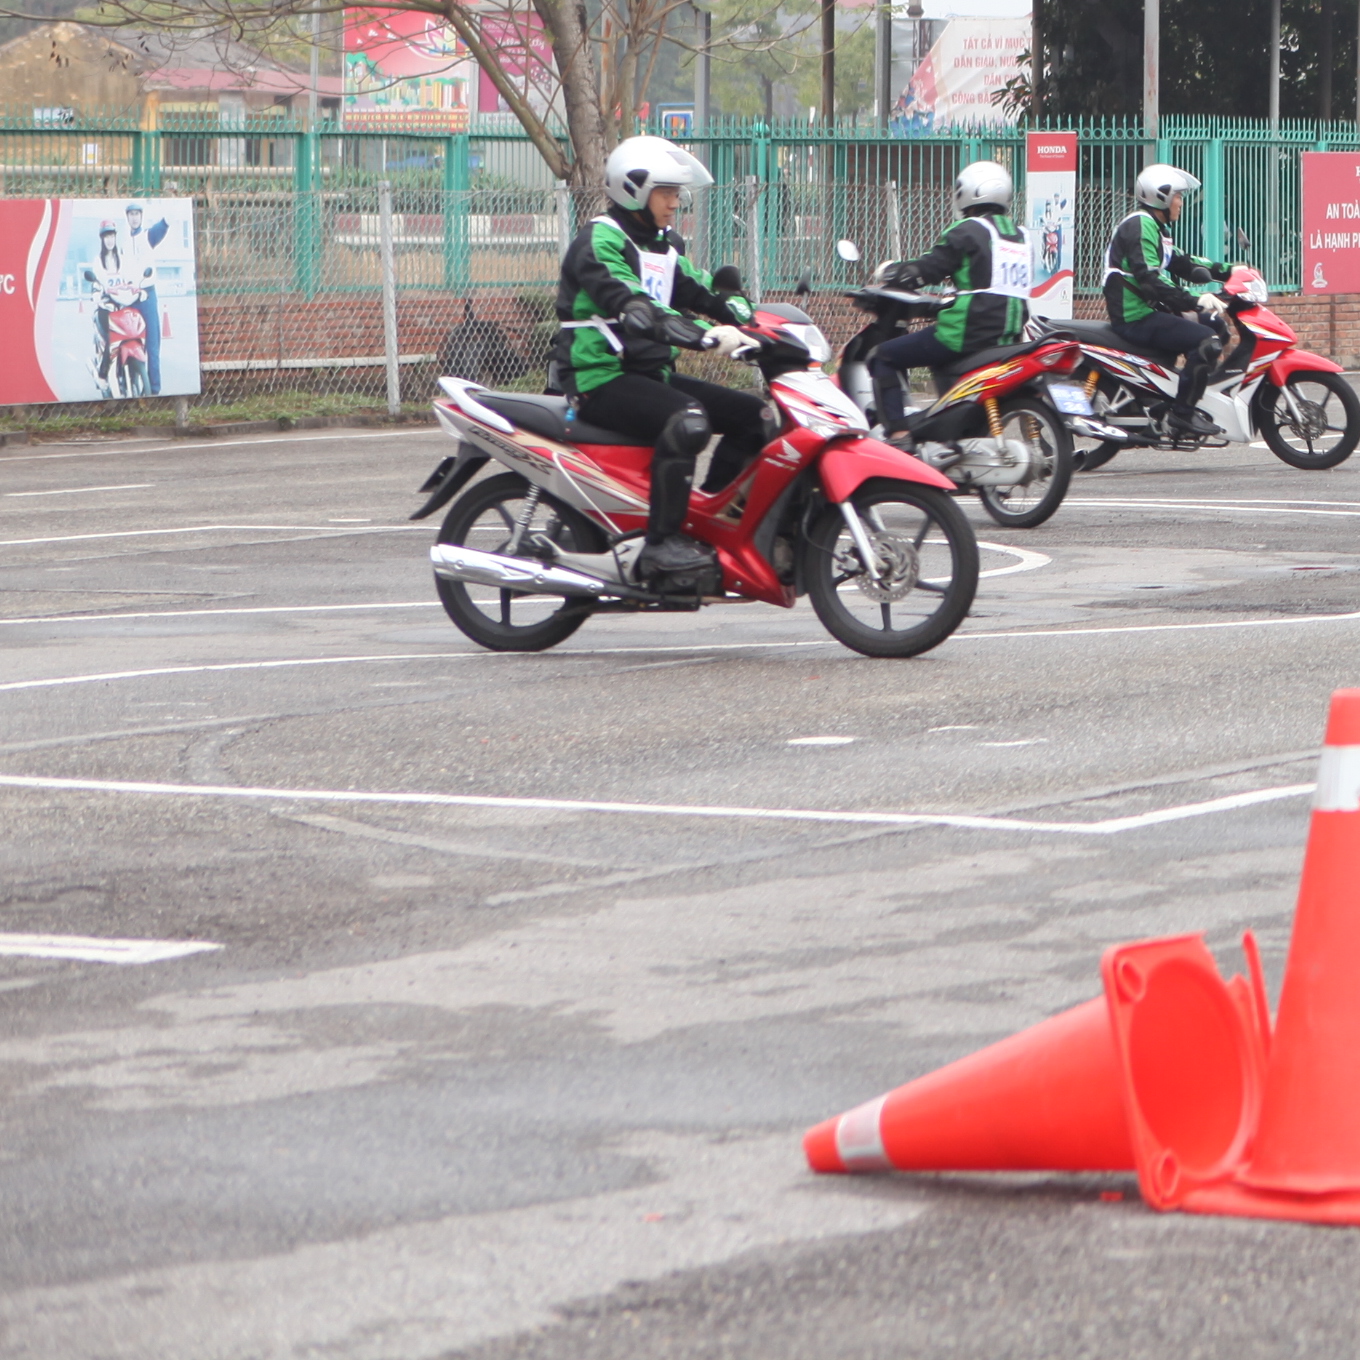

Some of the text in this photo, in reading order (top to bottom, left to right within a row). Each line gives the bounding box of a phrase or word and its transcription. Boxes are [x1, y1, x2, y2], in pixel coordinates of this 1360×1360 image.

[951, 90, 976, 104] CÔNG
[1036, 145, 1068, 154] HONDA
[1326, 203, 1339, 219] AN
[1310, 229, 1322, 249] LÀ
[1324, 232, 1350, 252] HẠNH
